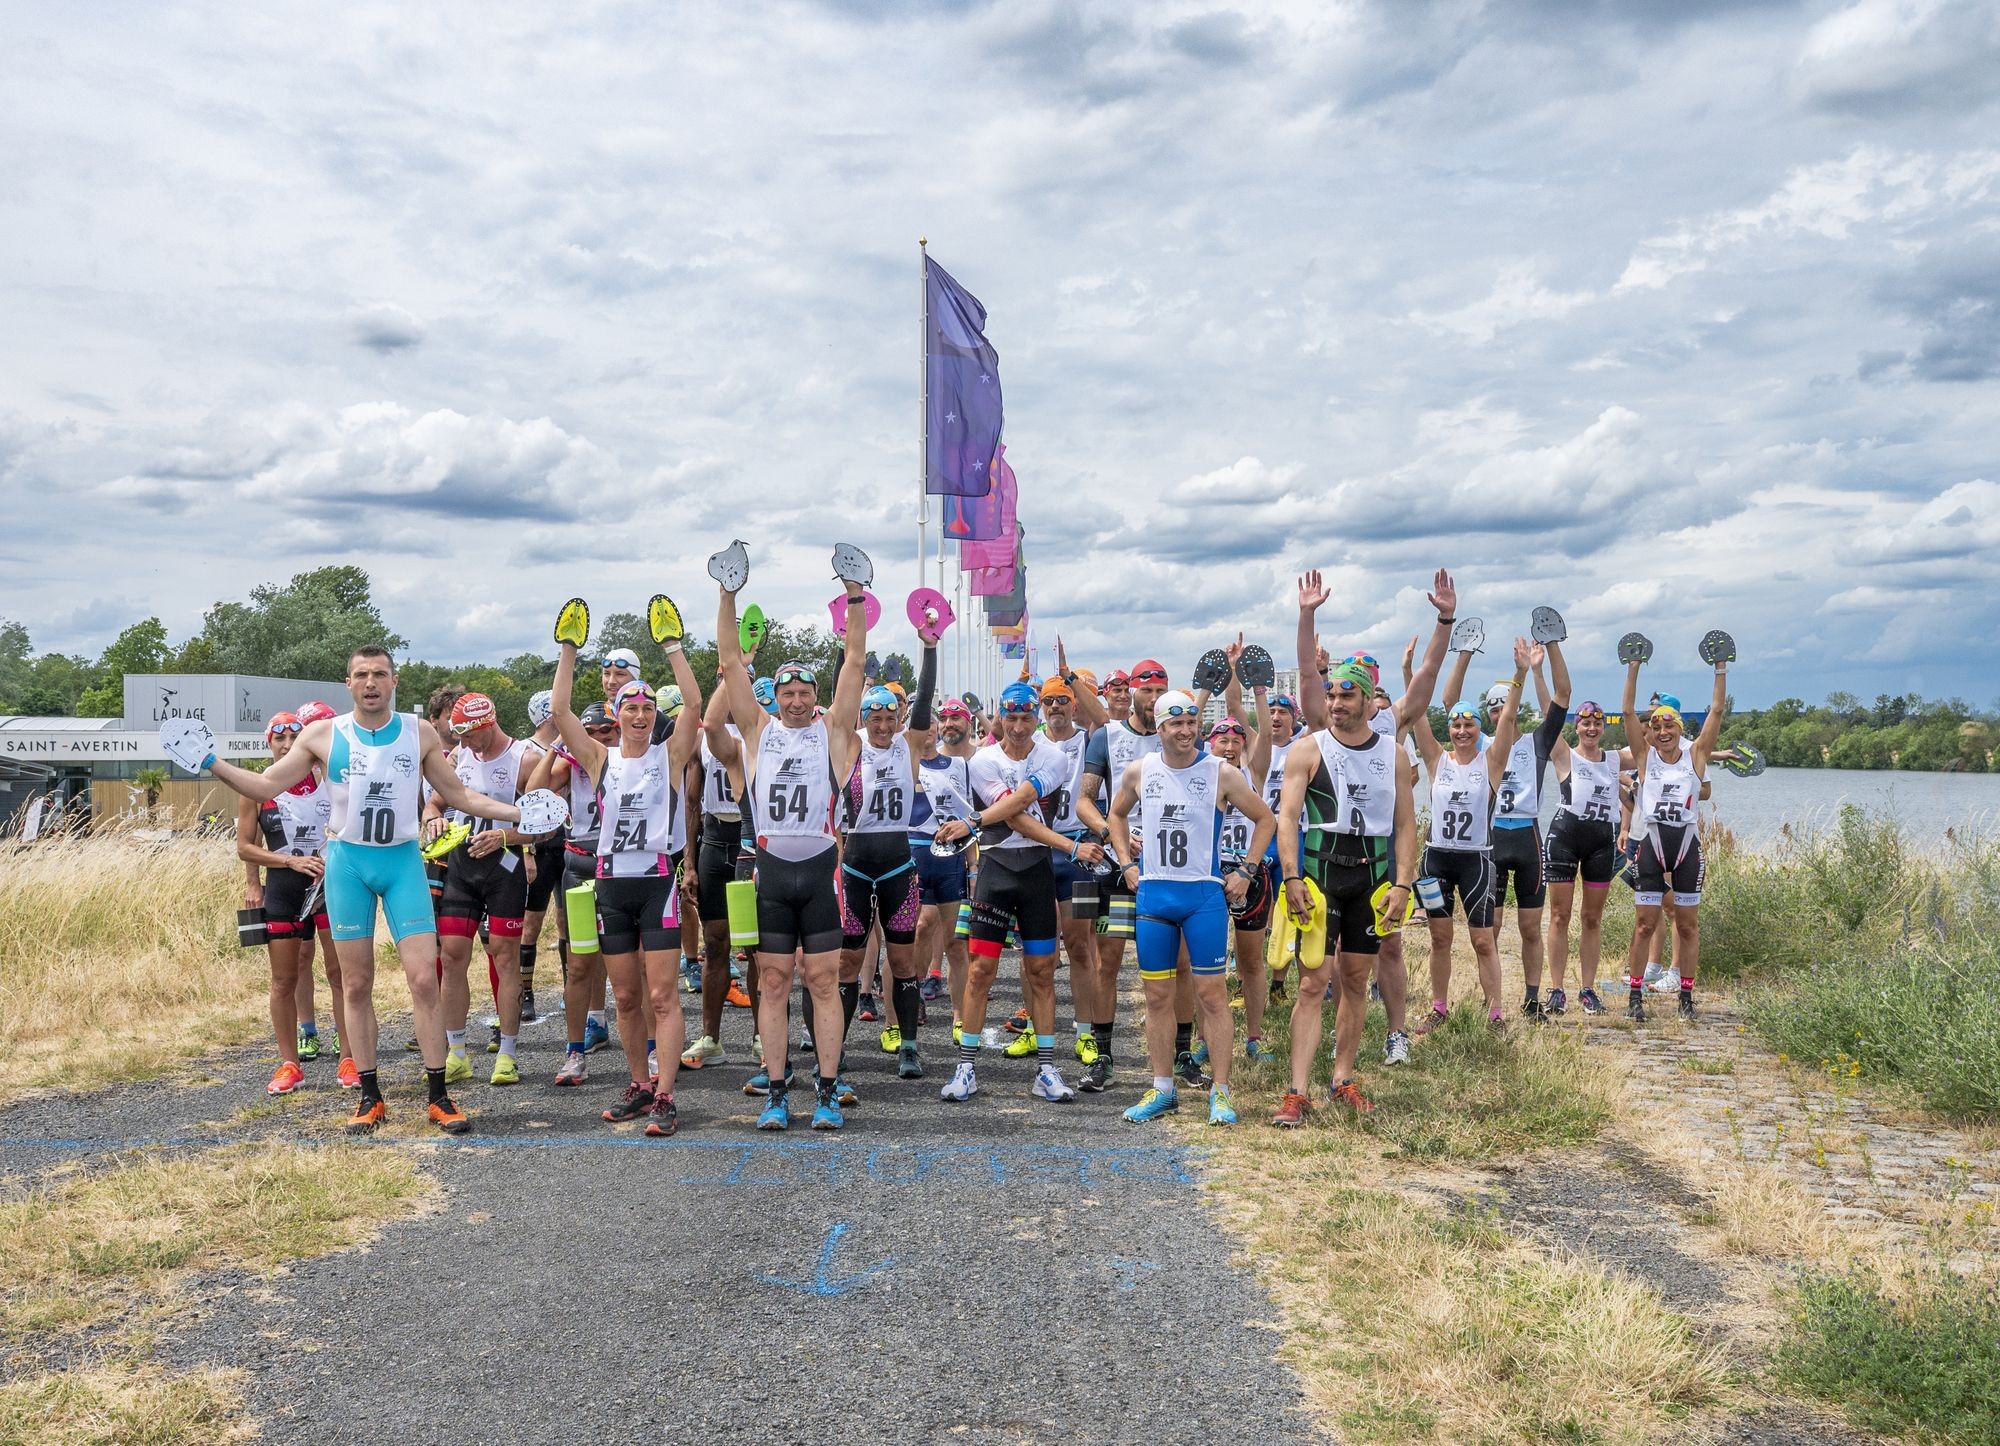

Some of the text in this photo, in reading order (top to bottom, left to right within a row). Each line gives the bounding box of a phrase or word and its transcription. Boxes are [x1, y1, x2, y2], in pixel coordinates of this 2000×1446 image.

[153, 707, 206, 721] LA PLAGE
[239, 708, 262, 722] LA PLAGE
[228, 740, 270, 750] PISCINE DE SA
[769, 784, 808, 822] 54
[869, 787, 903, 821] 46
[1579, 800, 1611, 822] 55
[1653, 801, 1683, 822] 55
[360, 807, 396, 845] 10
[611, 819, 648, 853] 54
[1349, 807, 1366, 836] 9
[1442, 810, 1473, 840] 32
[1157, 830, 1188, 868] 18
[1695, 846, 1706, 892] RUNNING
